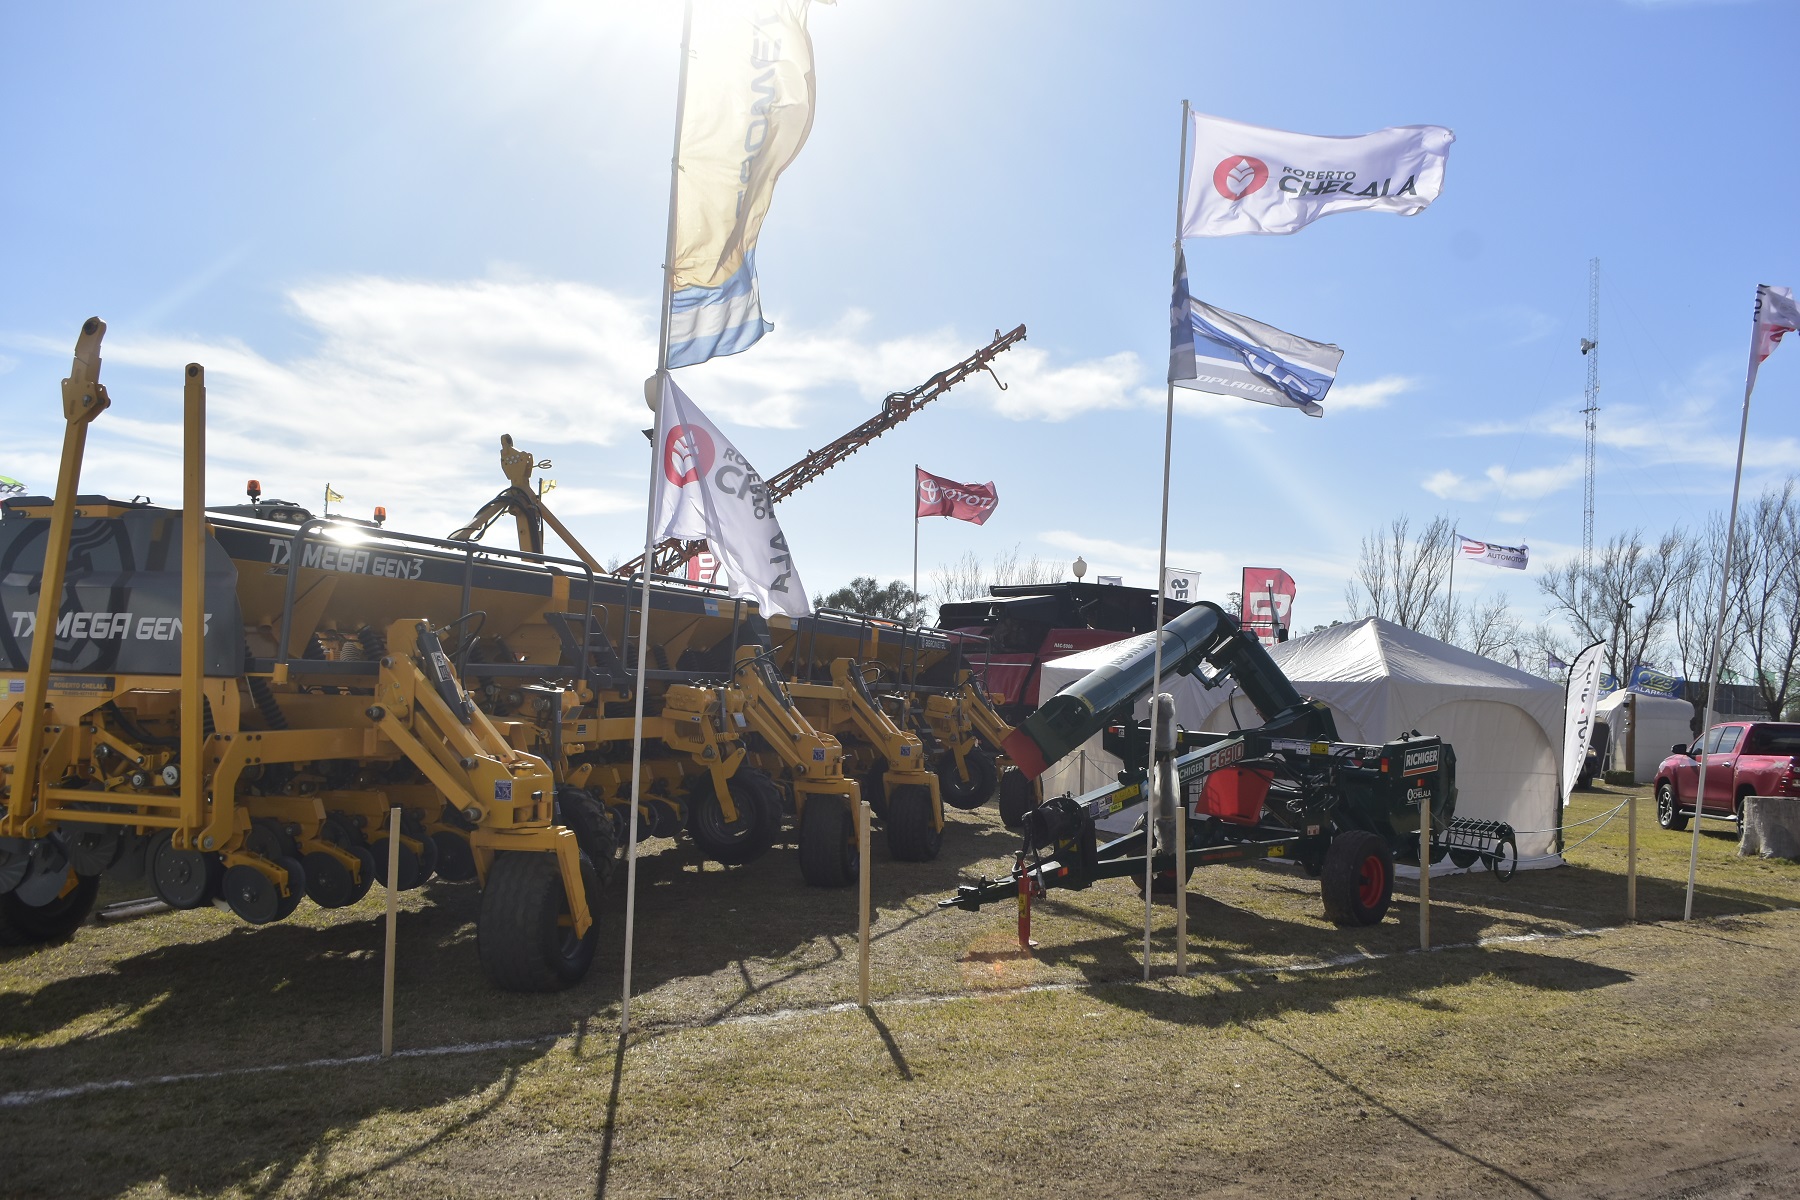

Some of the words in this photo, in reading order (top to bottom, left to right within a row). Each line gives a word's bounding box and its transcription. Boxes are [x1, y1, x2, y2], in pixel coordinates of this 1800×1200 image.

[1283, 166, 1357, 180] ROBERTO
[1278, 174, 1418, 197] CHELALA
[1195, 373, 1277, 396] OPLADOS
[302, 543, 370, 575] MEGA
[372, 556, 424, 580] GEN3
[55, 611, 133, 640] MEGA
[53, 682, 80, 690] ROBERTO
[81, 682, 108, 690] CHELALA
[1634, 685, 1674, 698] ALARMAS
[1406, 750, 1438, 767] RICHIGER
[1180, 762, 1204, 779] CHIGER
